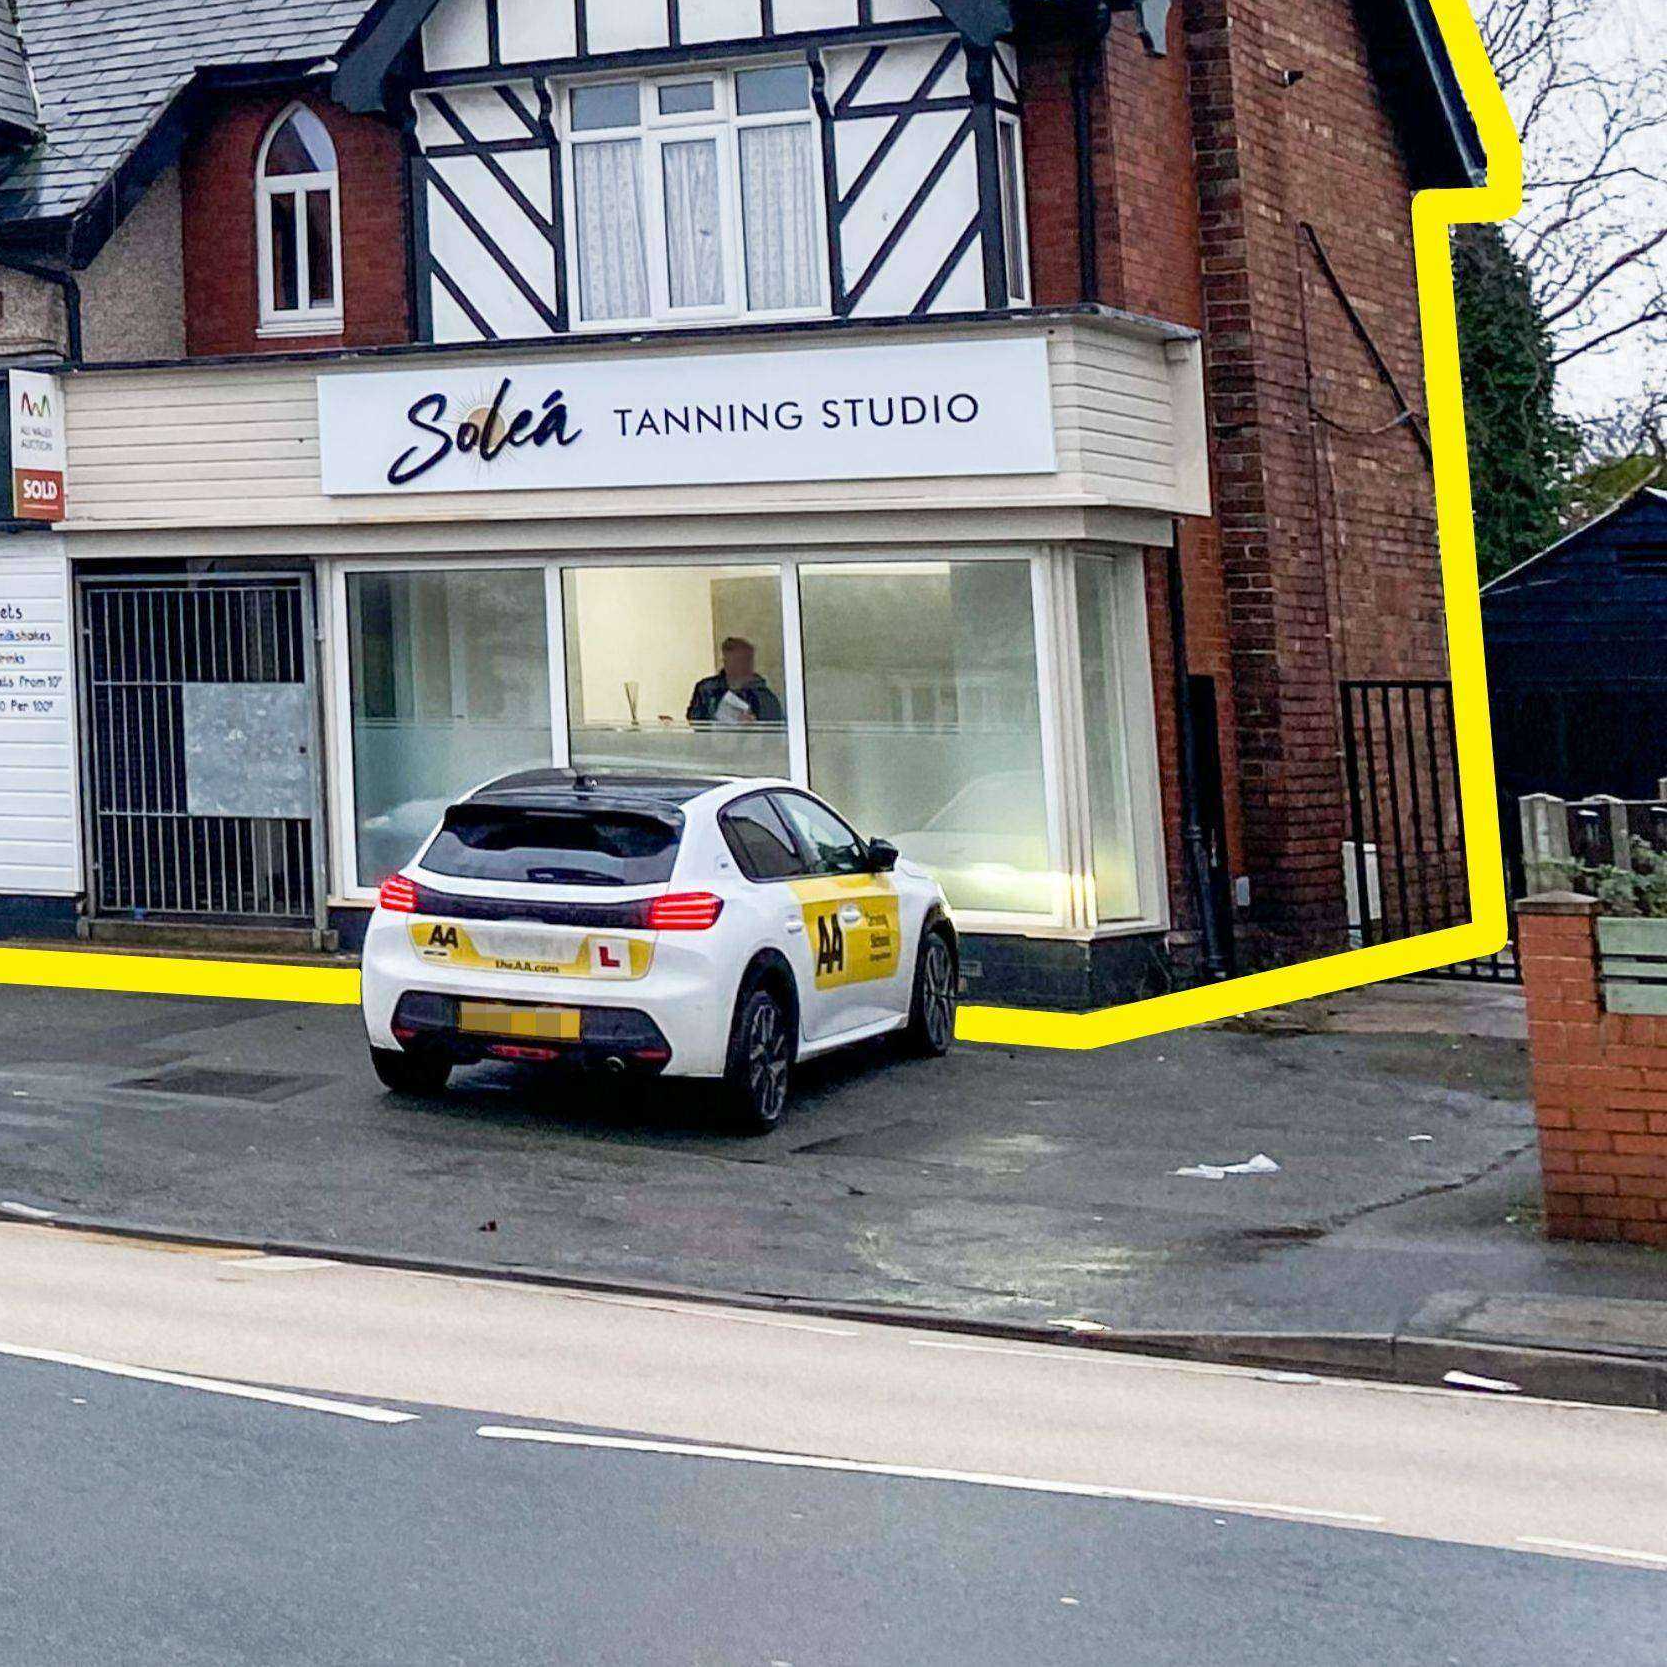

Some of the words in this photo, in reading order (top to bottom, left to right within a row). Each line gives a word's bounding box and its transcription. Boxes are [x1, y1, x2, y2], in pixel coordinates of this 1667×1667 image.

[613, 401, 803, 436] TANNING
[822, 393, 978, 428] STUDIO
[23, 479, 58, 499] SOLD
[428, 924, 458, 948] AA
[815, 913, 843, 976] AA
[495, 958, 559, 973] theAA.com
[598, 946, 621, 967] L
